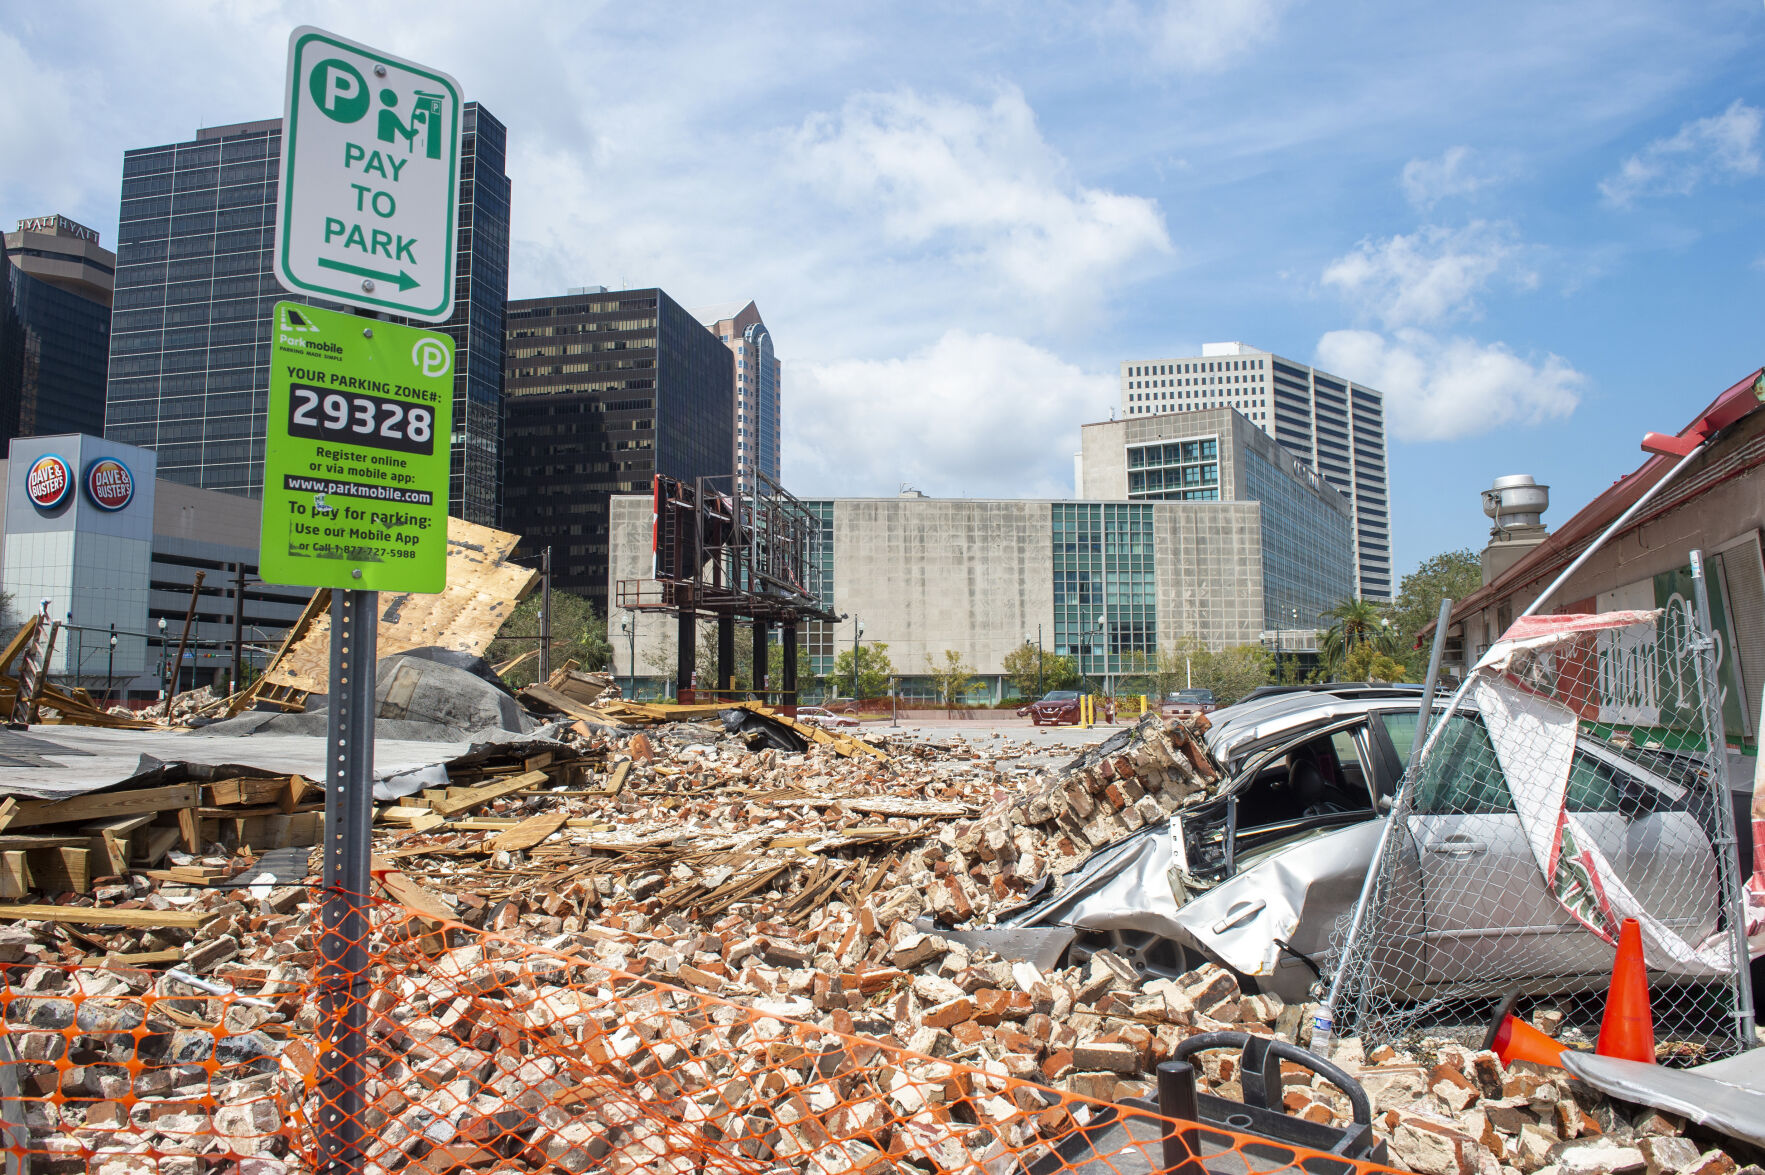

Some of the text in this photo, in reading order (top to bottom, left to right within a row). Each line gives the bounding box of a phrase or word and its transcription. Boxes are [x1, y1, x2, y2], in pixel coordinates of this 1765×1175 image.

[344, 141, 408, 182] PAY
[350, 183, 397, 218] TO
[17, 216, 56, 231] HYATT
[60, 218, 99, 242] HYATT
[324, 216, 418, 265] PARK
[279, 334, 343, 354] Parkmobile
[279, 346, 304, 355] PARKING
[306, 351, 322, 359] MADE
[287, 366, 442, 403] YOUR PARKING ZONE#:
[293, 389, 432, 443] 29328
[316, 446, 407, 468] Register online
[32, 464, 63, 486] DAVE &
[96, 469, 129, 486] DAVE &
[309, 462, 416, 484] or via mobile app:
[32, 476, 64, 497] BUSTER'S
[97, 483, 131, 498] BUSTER'S
[288, 478, 431, 504] www.parkmobile.com
[288, 501, 432, 530] To pay for parking:
[295, 523, 420, 546] Use our Mobile App
[299, 543, 310, 551] or
[313, 542, 331, 552] Call
